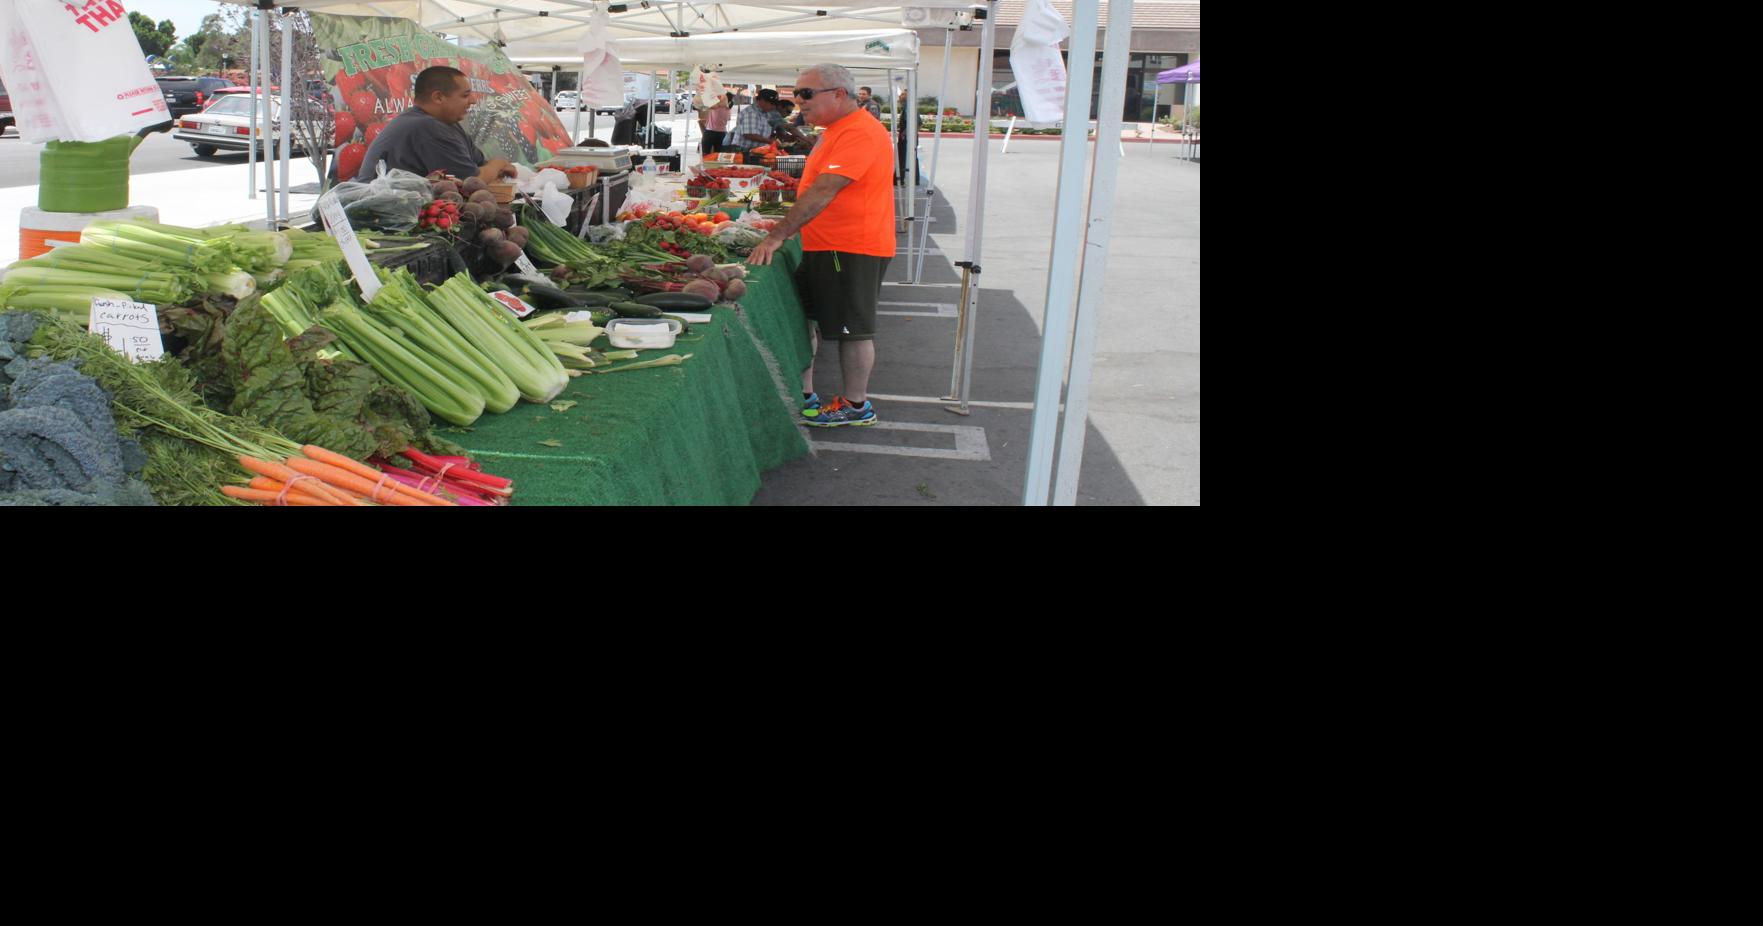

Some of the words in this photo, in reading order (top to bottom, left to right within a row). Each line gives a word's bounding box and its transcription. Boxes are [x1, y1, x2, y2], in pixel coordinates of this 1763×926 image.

[76, 0, 125, 33] THA
[336, 35, 411, 76] FRESH
[374, 98, 414, 114] ALWA
